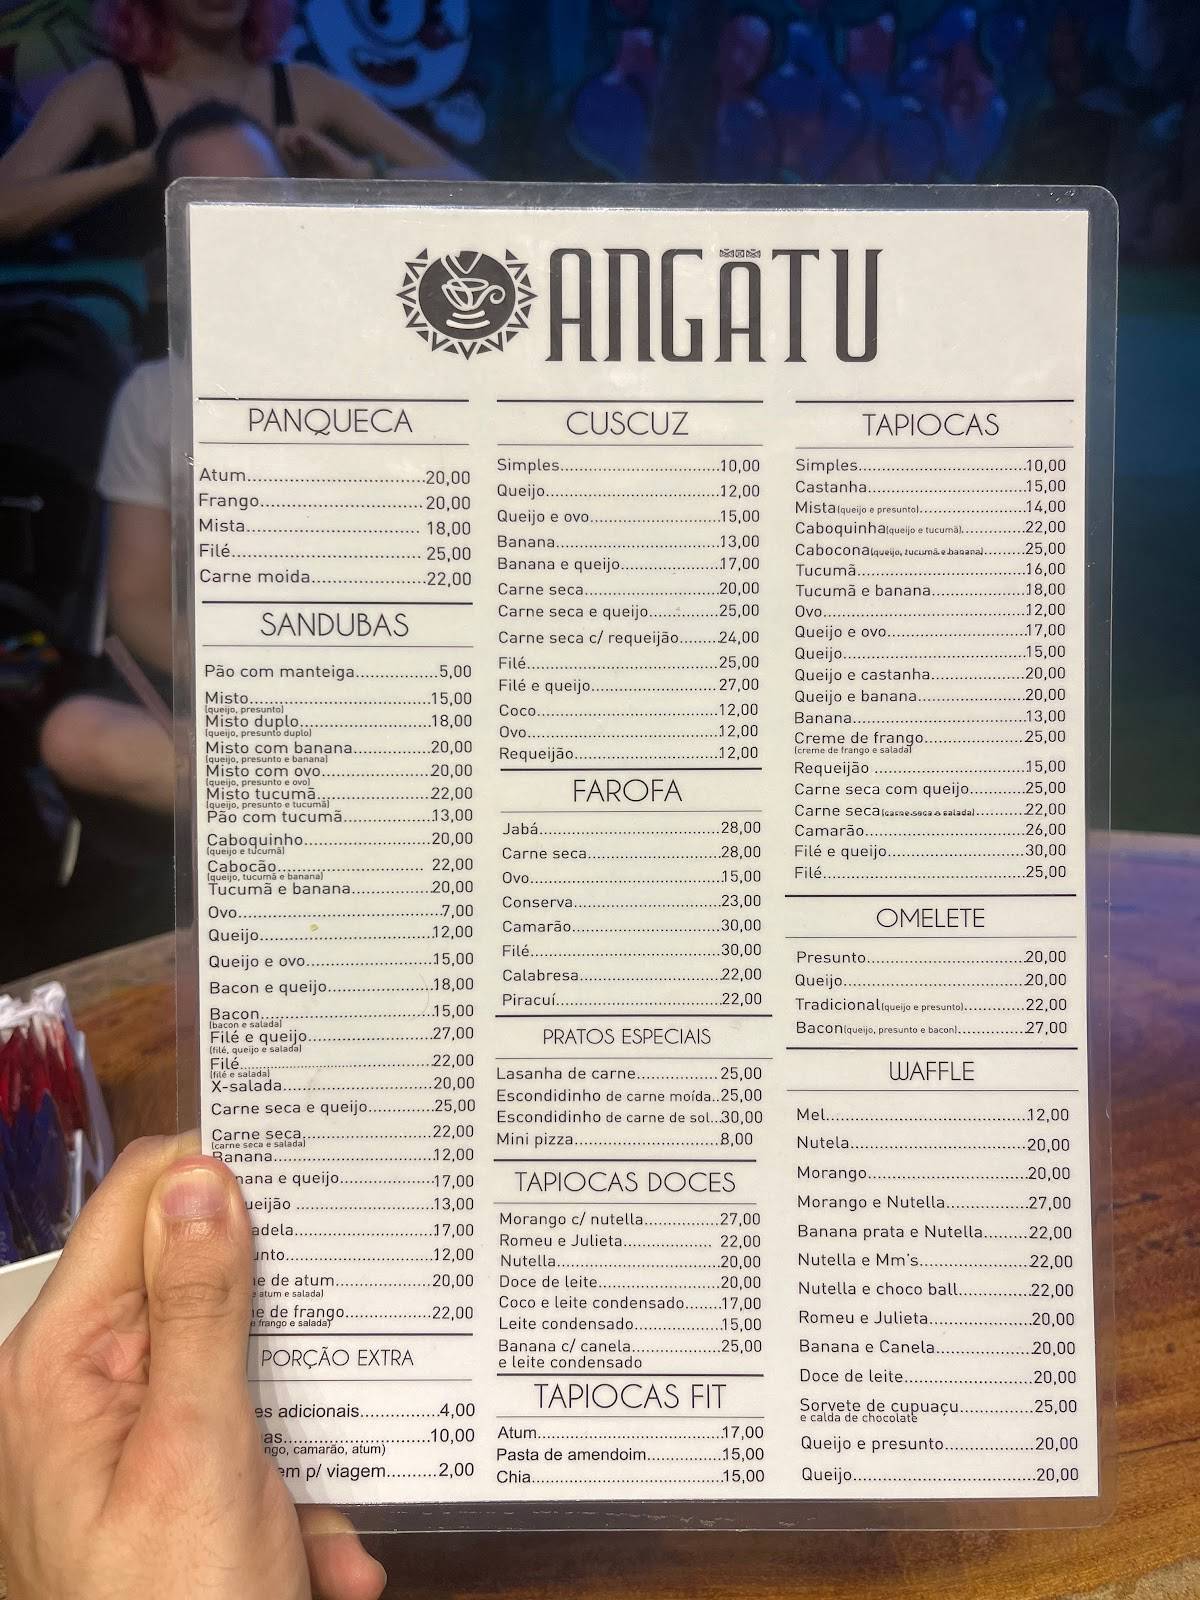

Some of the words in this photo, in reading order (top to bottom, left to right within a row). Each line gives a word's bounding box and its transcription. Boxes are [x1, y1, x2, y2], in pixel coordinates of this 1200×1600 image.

[249, 408, 413, 436] PANQUECA
[566, 411, 689, 436] CUSCUZ
[862, 413, 999, 436] TAPIOCAS
[497, 458, 560, 475] Simples
[721, 459, 760, 474] 10,00
[199, 467, 246, 482] Atum
[426, 470, 470, 487] 20,00
[497, 484, 545, 500] Queijo
[721, 484, 760, 499] 12,00
[795, 480, 867, 493] Castanha
[1026, 479, 1066, 494] 15,00
[199, 493, 259, 511] Frango
[426, 496, 471, 512] 20,00
[199, 518, 245, 532] Mista
[427, 521, 471, 537] 18,00
[497, 535, 555, 548] Banana
[720, 534, 760, 549] 13,00
[200, 543, 230, 558] Filé
[427, 546, 471, 563] 25,00
[796, 564, 856, 577] Tucumã
[1026, 562, 1066, 577] 16,00
[200, 569, 251, 583] Carne
[258, 569, 310, 583] moida
[427, 571, 471, 588] 22,00
[498, 582, 544, 596] Carne
[549, 586, 583, 596] seca
[719, 581, 760, 596] 20,00
[260, 612, 409, 637] SANDUBAS
[498, 631, 544, 644] Carne
[549, 634, 584, 644] seca
[589, 630, 604, 645] c/
[608, 631, 679, 647] requeijão
[717, 630, 759, 646] 24,00
[205, 664, 235, 678] Pão
[240, 668, 274, 678] com
[280, 664, 354, 682] manteiga
[440, 664, 472, 680] 5,00
[206, 691, 248, 704] Misto
[431, 691, 472, 707] 15,00
[499, 704, 536, 717] Coco
[719, 703, 758, 717] 12,00
[206, 714, 249, 728] Misto
[254, 714, 299, 731] duplo
[432, 714, 472, 729] 18,00
[241, 728, 281, 738] presunto
[794, 731, 845, 744] Creme
[850, 731, 869, 744] de
[873, 731, 924, 748] frango
[1024, 730, 1066, 744] 25,00
[499, 747, 574, 763] Requeijão
[719, 746, 758, 760] 12,00
[828, 746, 839, 754] de
[841, 746, 870, 755] frango
[574, 779, 683, 802] FAROFA
[207, 809, 237, 823] Pão
[242, 813, 276, 823] com
[281, 809, 342, 823] tucumã
[432, 808, 473, 823] 13,00
[502, 822, 538, 835] Jabá
[721, 821, 761, 836] 28,00
[794, 824, 864, 837] Camarão
[1026, 823, 1066, 837] 26,00
[207, 832, 303, 849] Caboquinho
[432, 832, 473, 847] 20,00
[795, 844, 822, 857] Filé
[827, 848, 836, 857] e
[841, 844, 887, 860] queijo
[1025, 843, 1066, 858] 30,00
[208, 860, 276, 873] Cabocão
[432, 857, 473, 873] 22,00
[502, 895, 573, 908] Conserva
[721, 894, 761, 909] 23,00
[502, 920, 571, 933] Camarão
[721, 918, 761, 933] 30,00
[876, 908, 985, 928] OMELETE
[208, 928, 259, 944] Queijo
[433, 925, 473, 940] 12,00
[797, 951, 866, 964] Presunto
[1023, 950, 1066, 965] 20,00
[502, 969, 579, 982] Calabresa
[720, 968, 762, 982] 22,00
[210, 981, 259, 994] Bacon
[264, 984, 274, 993] e
[279, 979, 327, 997] queijo
[434, 977, 474, 992] 18,00
[502, 992, 556, 1006] Piracuí
[722, 992, 762, 1007] 22,00
[543, 1028, 615, 1045] PRATOS
[622, 1028, 711, 1045] ESPECIAIS
[497, 1067, 562, 1080] Lasanha
[568, 1067, 586, 1080] de
[591, 1070, 636, 1080] carne
[720, 1066, 762, 1082] 25,00
[889, 1061, 975, 1081] WAFFLE
[212, 1079, 282, 1093] X-salada
[434, 1076, 475, 1091] 20,00
[797, 1108, 826, 1121] Mel
[1028, 1108, 1069, 1123] 12,00
[497, 1132, 529, 1145] Mini
[535, 1132, 573, 1149] pizza
[720, 1132, 753, 1147] 8,00
[797, 1135, 849, 1149] Nutela
[1027, 1138, 1070, 1153] 20,00
[514, 1171, 638, 1192] TAPIOCAS
[648, 1172, 736, 1193] DOCES
[500, 1212, 566, 1229] Morango
[571, 1211, 586, 1226] c/
[591, 1212, 643, 1226] nutella
[720, 1212, 761, 1227] 27,00
[501, 1254, 556, 1267] Nutella
[721, 1255, 761, 1270] 20,00
[798, 1252, 856, 1266] Nutella
[861, 1256, 870, 1266] e
[876, 1253, 919, 1267] Mm's
[1029, 1254, 1073, 1270] 22,00
[499, 1275, 536, 1288] Doce
[542, 1275, 560, 1288] de
[565, 1275, 597, 1288] leite
[721, 1275, 761, 1291] 20,00
[262, 1346, 350, 1370] PORÇÃO
[357, 1349, 414, 1366] EXTRA
[534, 1383, 679, 1409] TAPIOCAS
[691, 1384, 727, 1409] FIT
[800, 1397, 861, 1412] Sorvete
[866, 1398, 885, 1413] de
[891, 1402, 959, 1417] cupuaçu
[1034, 1399, 1077, 1415] 25,00
[810, 1413, 841, 1422] calda
[844, 1413, 858, 1423] de
[862, 1413, 918, 1423] chocolate
[497, 1426, 537, 1439] Atum
[722, 1425, 764, 1441] 17,00
[496, 1448, 539, 1461] Pasta
[544, 1447, 563, 1461] de
[567, 1447, 646, 1461] amendoim
[722, 1447, 765, 1463] 15,00
[496, 1470, 531, 1484] Chia
[723, 1469, 765, 1484] 15,00
